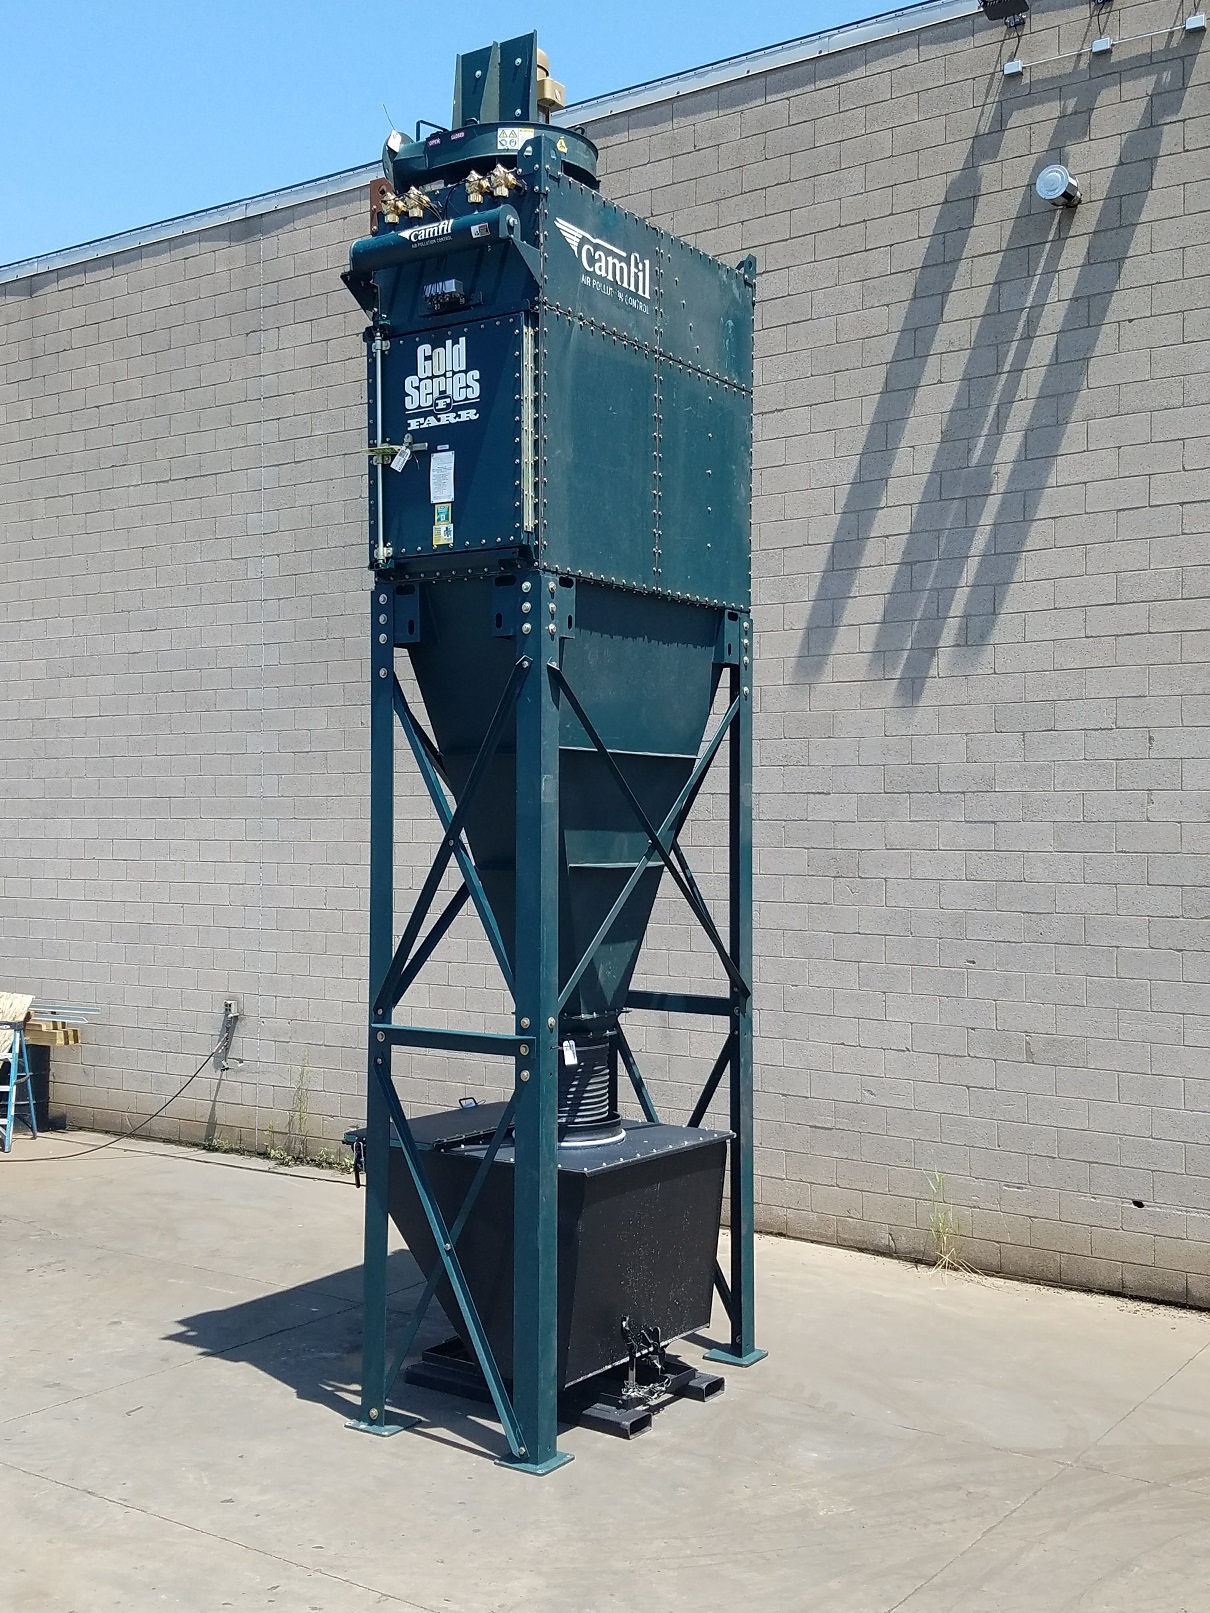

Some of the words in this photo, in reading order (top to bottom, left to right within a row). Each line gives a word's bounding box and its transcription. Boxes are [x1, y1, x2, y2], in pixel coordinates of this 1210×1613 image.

[581, 274, 591, 286] AIR
[624, 294, 650, 315] CONTROL
[417, 337, 466, 379] Gold
[404, 370, 480, 410] Series
[407, 409, 480, 431] FARR
